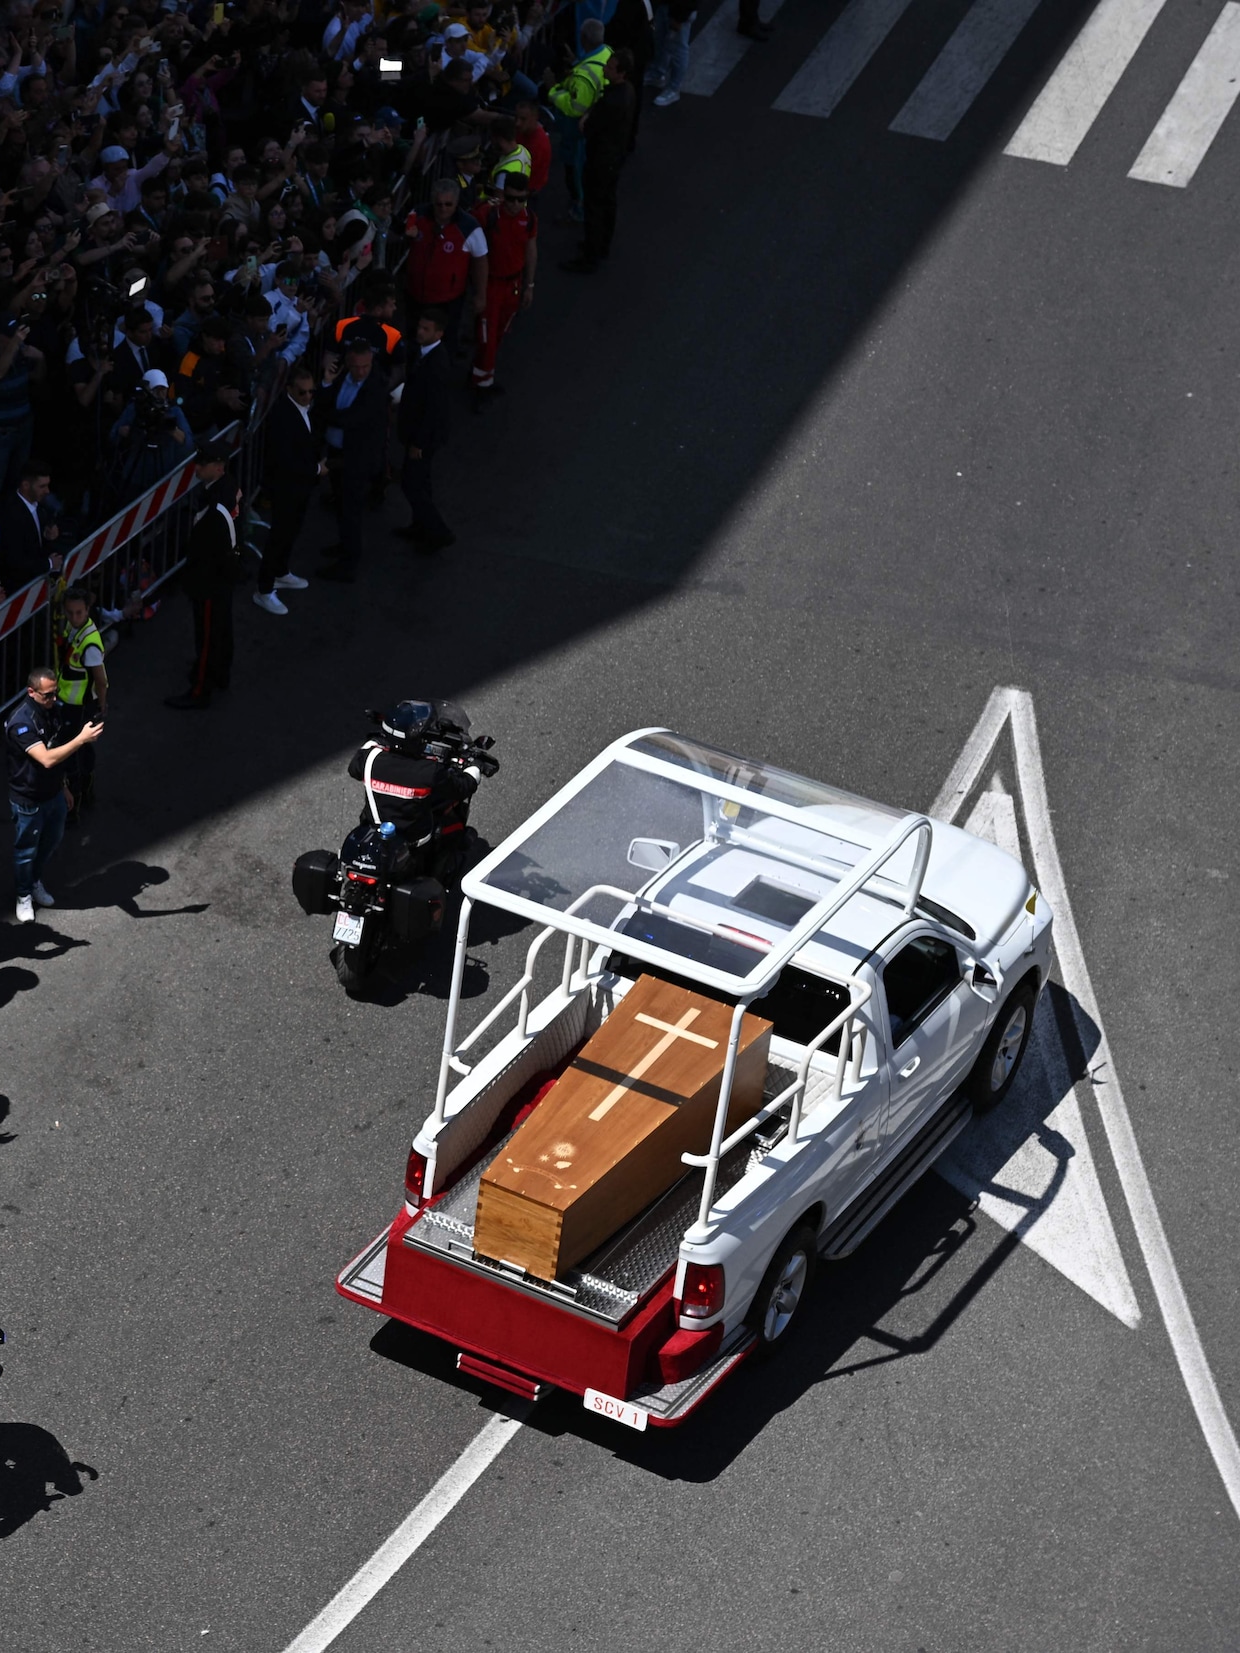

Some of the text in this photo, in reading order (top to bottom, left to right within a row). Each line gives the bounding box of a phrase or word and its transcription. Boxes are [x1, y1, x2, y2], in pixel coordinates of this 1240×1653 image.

[337, 913, 350, 927] CC
[336, 927, 360, 941] 7725
[593, 1396, 638, 1425] SCV 1
